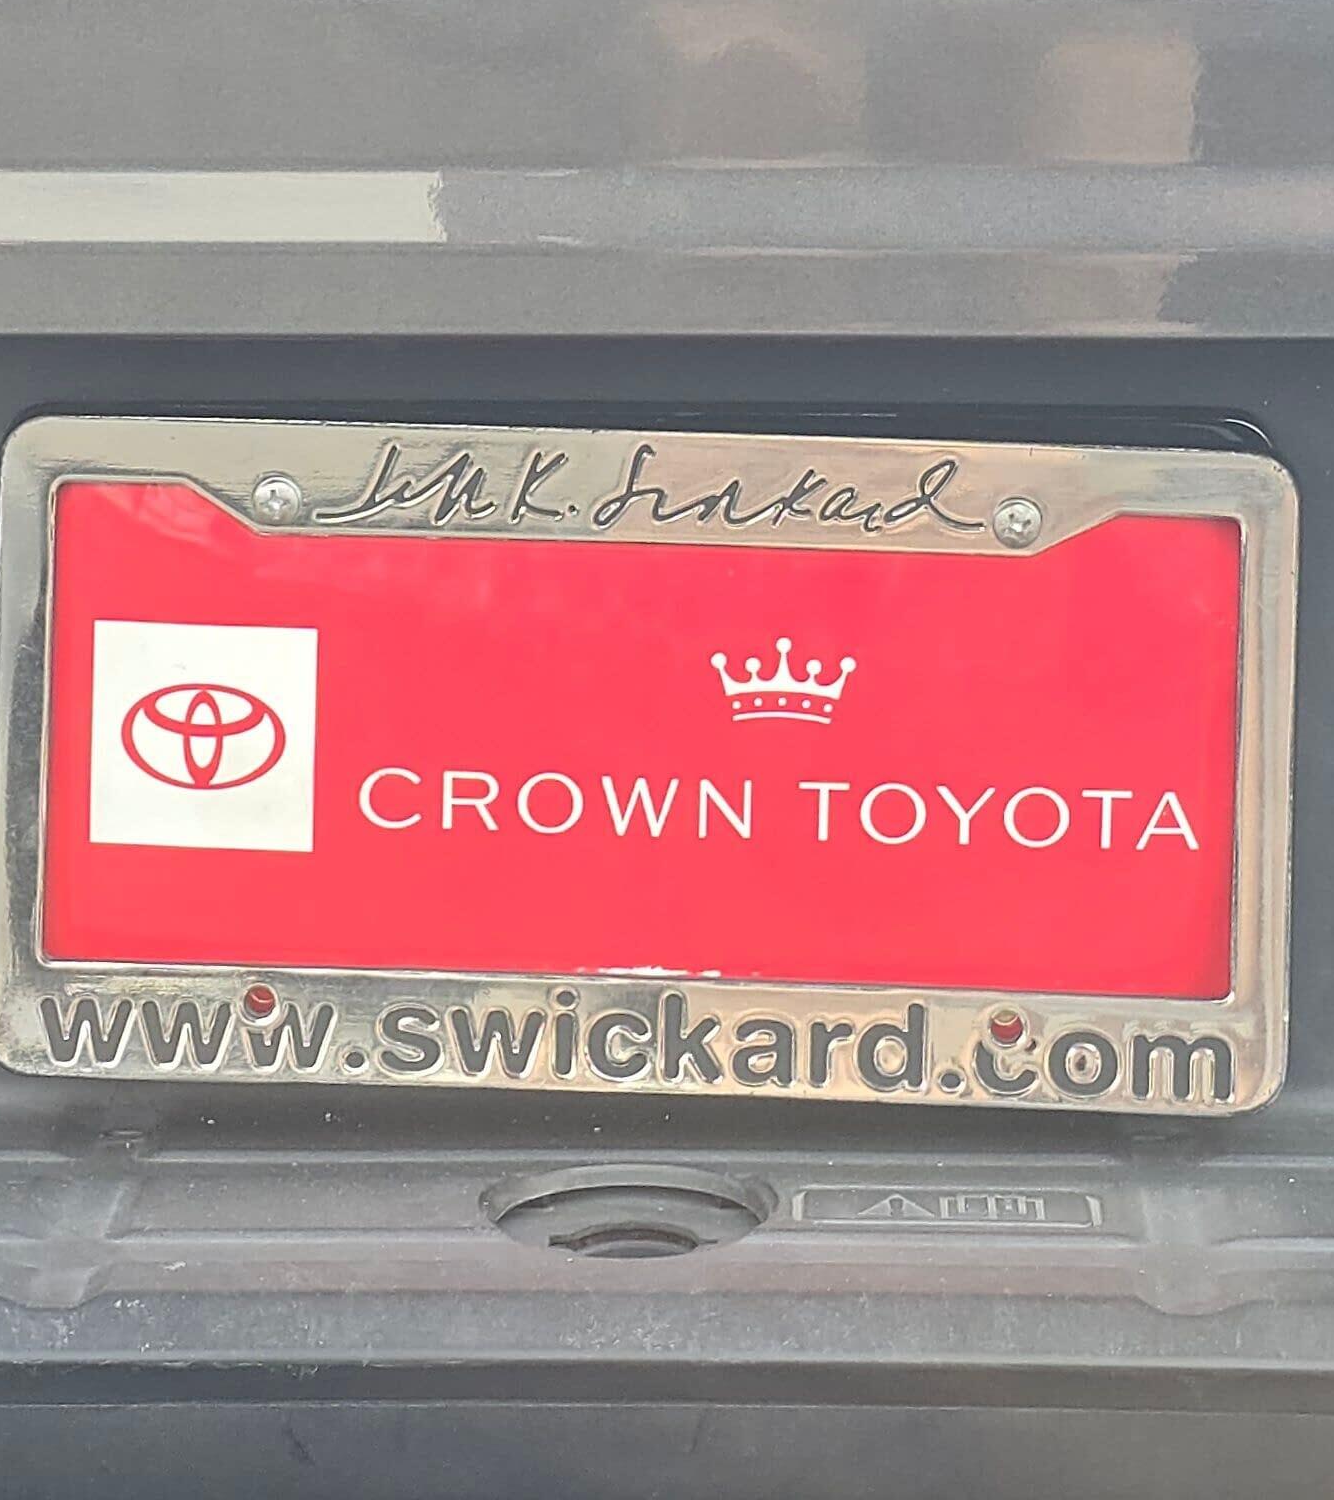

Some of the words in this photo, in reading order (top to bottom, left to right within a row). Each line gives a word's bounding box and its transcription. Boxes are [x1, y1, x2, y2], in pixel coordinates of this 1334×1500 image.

[357, 765, 754, 840] CROWN
[798, 780, 1201, 852] TOYOTA
[38, 989, 1237, 1105] www.swickard.com
